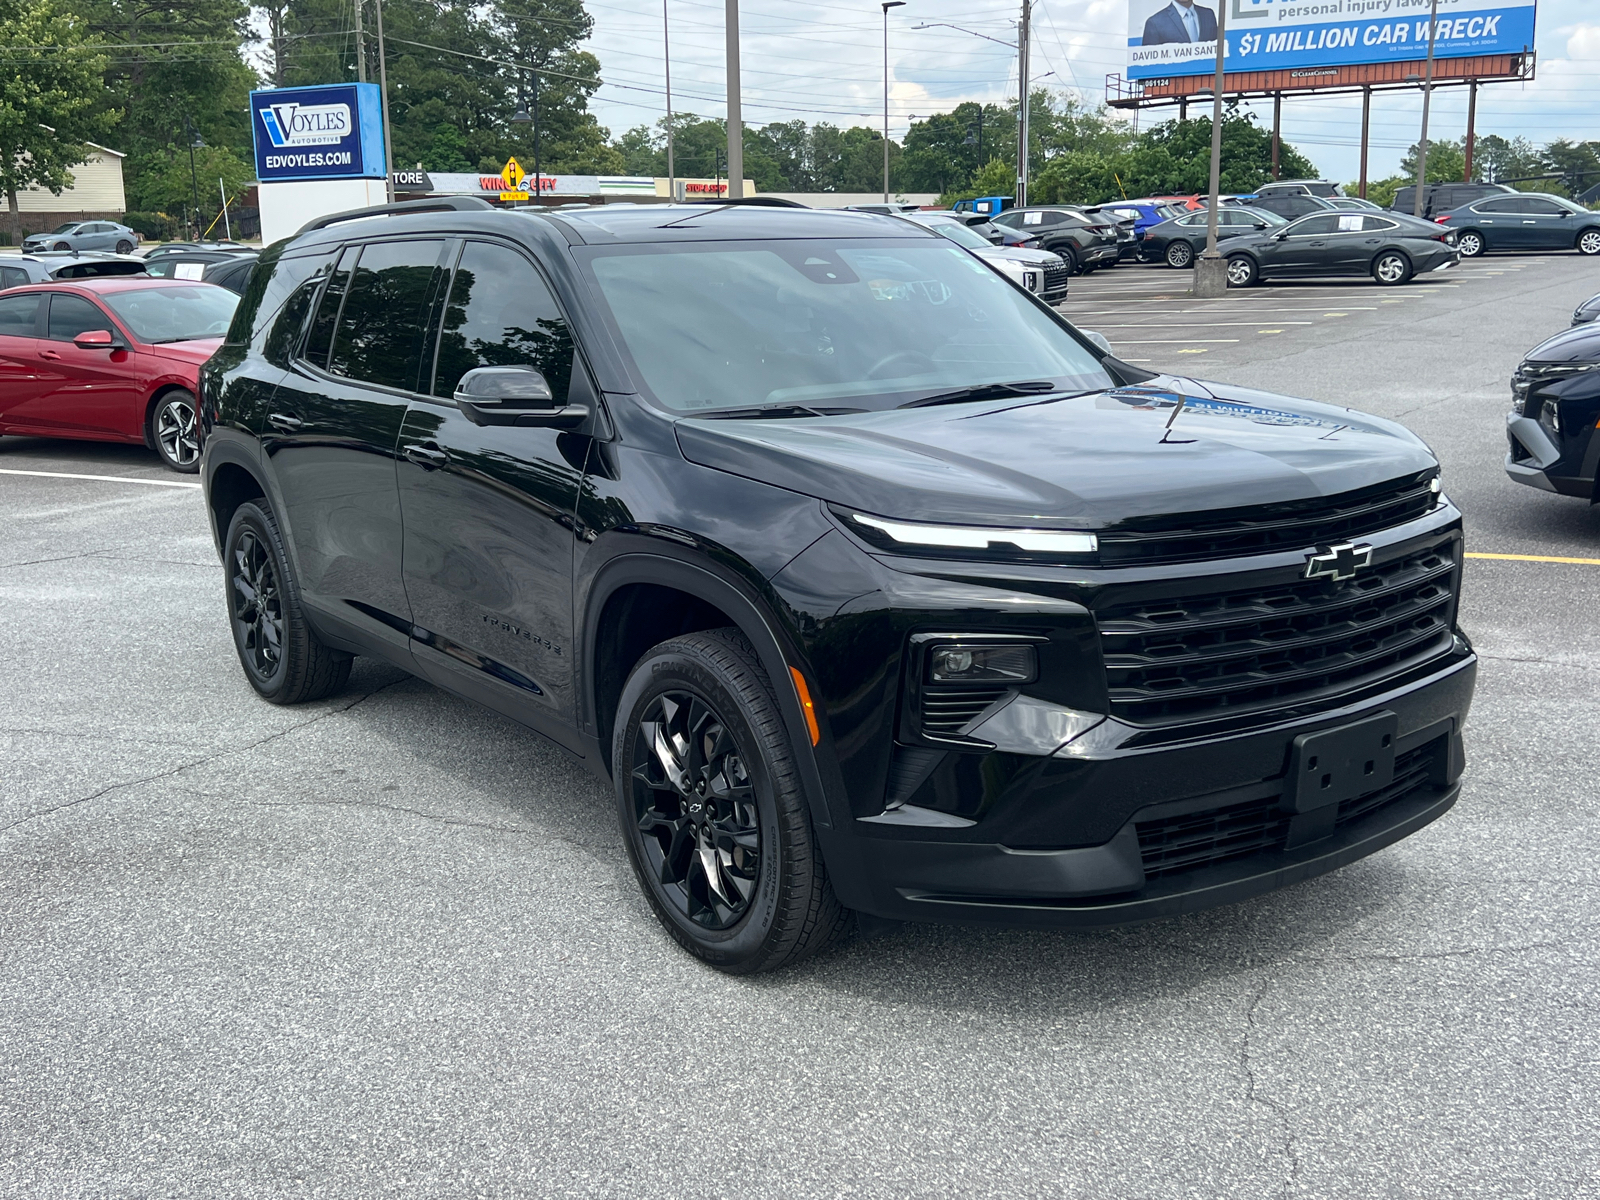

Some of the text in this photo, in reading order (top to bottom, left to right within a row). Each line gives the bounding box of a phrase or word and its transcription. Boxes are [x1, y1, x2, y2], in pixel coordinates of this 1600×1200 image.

[1279, 1, 1343, 21] personal
[1347, 0, 1392, 14] injury
[1238, 15, 1502, 57] $1 MILLION CAR WRECK
[1132, 51, 1159, 61] DAVID
[1161, 49, 1172, 58] M.
[1174, 47, 1192, 57] VAN
[272, 105, 345, 141] VOYLES
[265, 152, 352, 168] EDVOYLES.COM
[530, 178, 557, 190] CITY
[686, 184, 704, 192] STOP
[480, 613, 562, 656] TRAVERSE
[651, 661, 745, 742] CONTINENTAL
[769, 825, 778, 903] CROSSCONTACT
